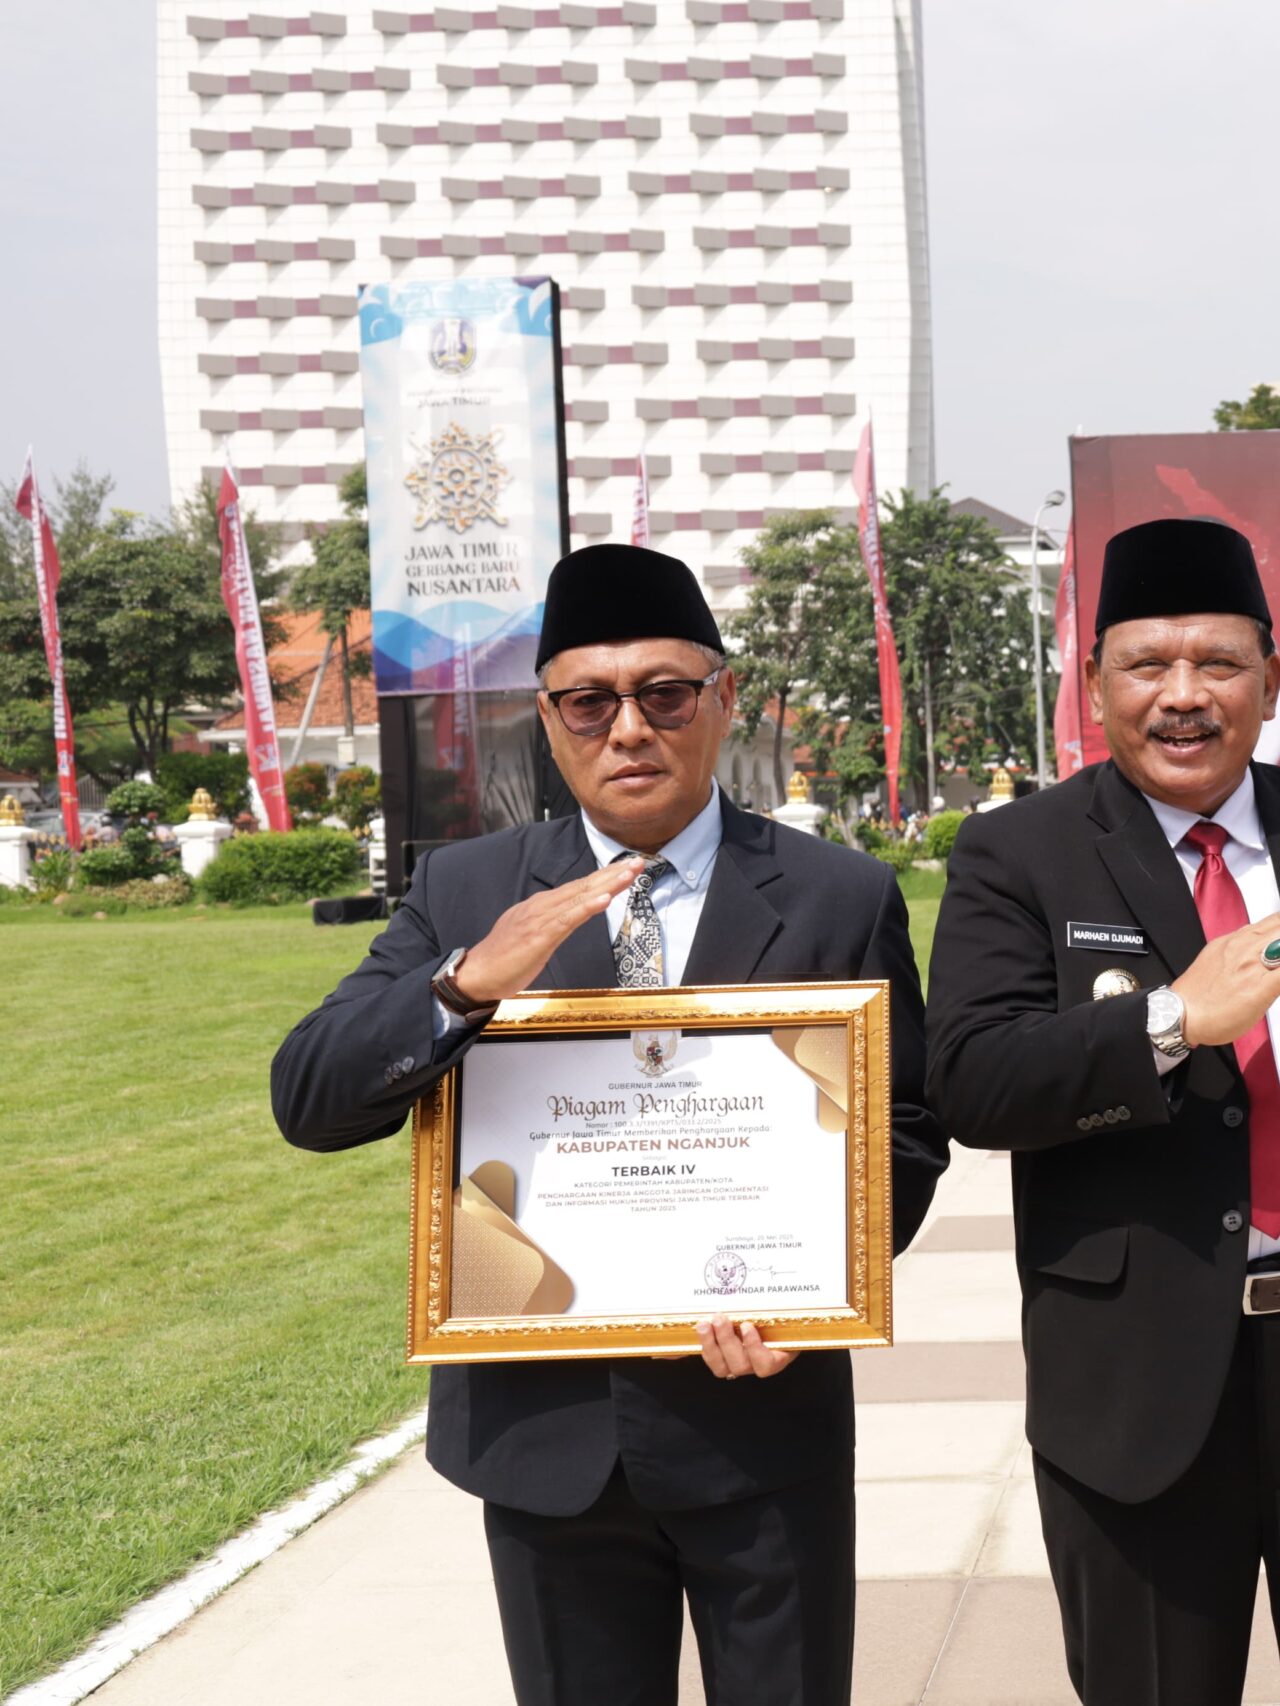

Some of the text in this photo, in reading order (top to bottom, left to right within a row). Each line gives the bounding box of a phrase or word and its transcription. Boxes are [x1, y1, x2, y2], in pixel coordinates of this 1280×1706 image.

[405, 542, 518, 561] JAWA TIMUR
[406, 560, 520, 578] GERBANG BARU
[407, 576, 521, 597] NUSANTARA
[1073, 930, 1144, 945] MARHAEN DJUMADI
[608, 1082, 653, 1090] GUBERNUR
[654, 1081, 677, 1089] JAWA
[547, 1090, 764, 1122] Piagam Penghargaan
[529, 1131, 570, 1140] Gubernur
[572, 1131, 594, 1139] Jawa
[596, 1129, 621, 1137] Timur
[624, 1128, 677, 1136] Memberikan
[679, 1126, 735, 1136] Penghargaan
[557, 1137, 751, 1154] KABUPATEN NGANJUK
[611, 1164, 696, 1177] TERBAIK IV
[613, 1179, 663, 1187] PEMERINTAH
[713, 1185, 769, 1193] DOKUMENTASI
[564, 1199, 607, 1207] INFORMASI
[716, 1243, 756, 1251] GUBERNUR
[738, 1286, 765, 1294] INDAR
[767, 1284, 821, 1293] PARAWANSA
